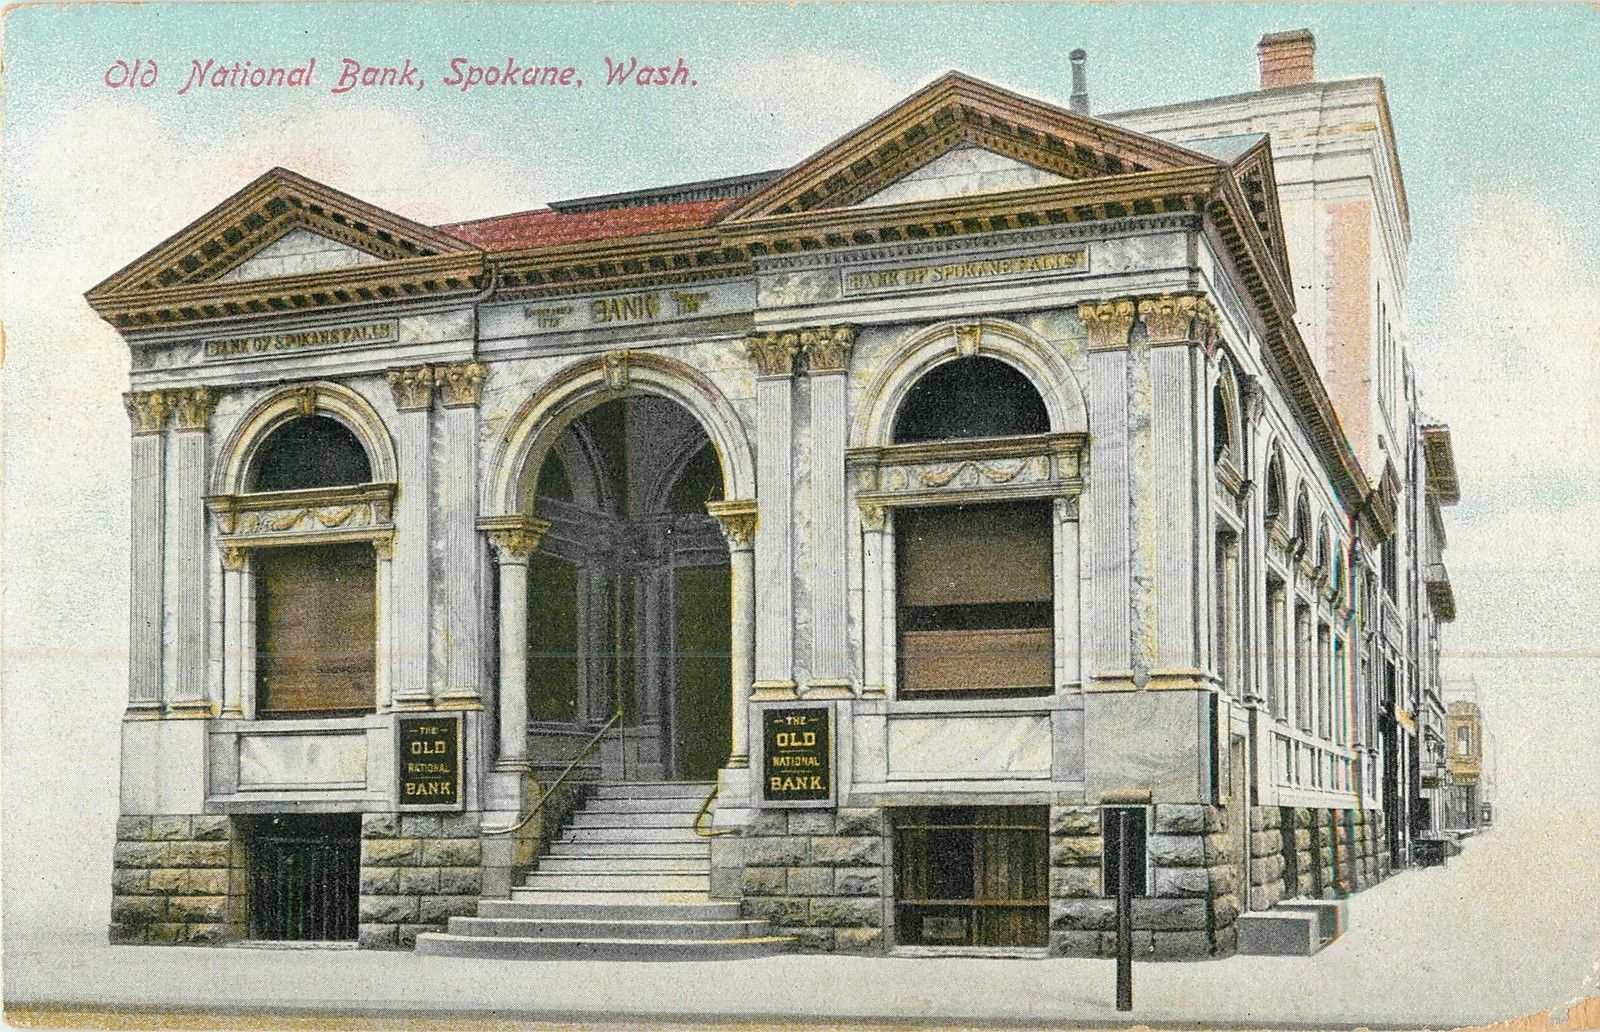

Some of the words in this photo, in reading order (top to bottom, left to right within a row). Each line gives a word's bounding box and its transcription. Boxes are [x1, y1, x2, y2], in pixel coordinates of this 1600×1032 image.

[931, 258, 1010, 283] SPOKANE
[786, 716, 807, 725] THE
[776, 731, 816, 747] OLD
[411, 741, 447, 755] OLD
[773, 756, 820, 767] NATIONAL
